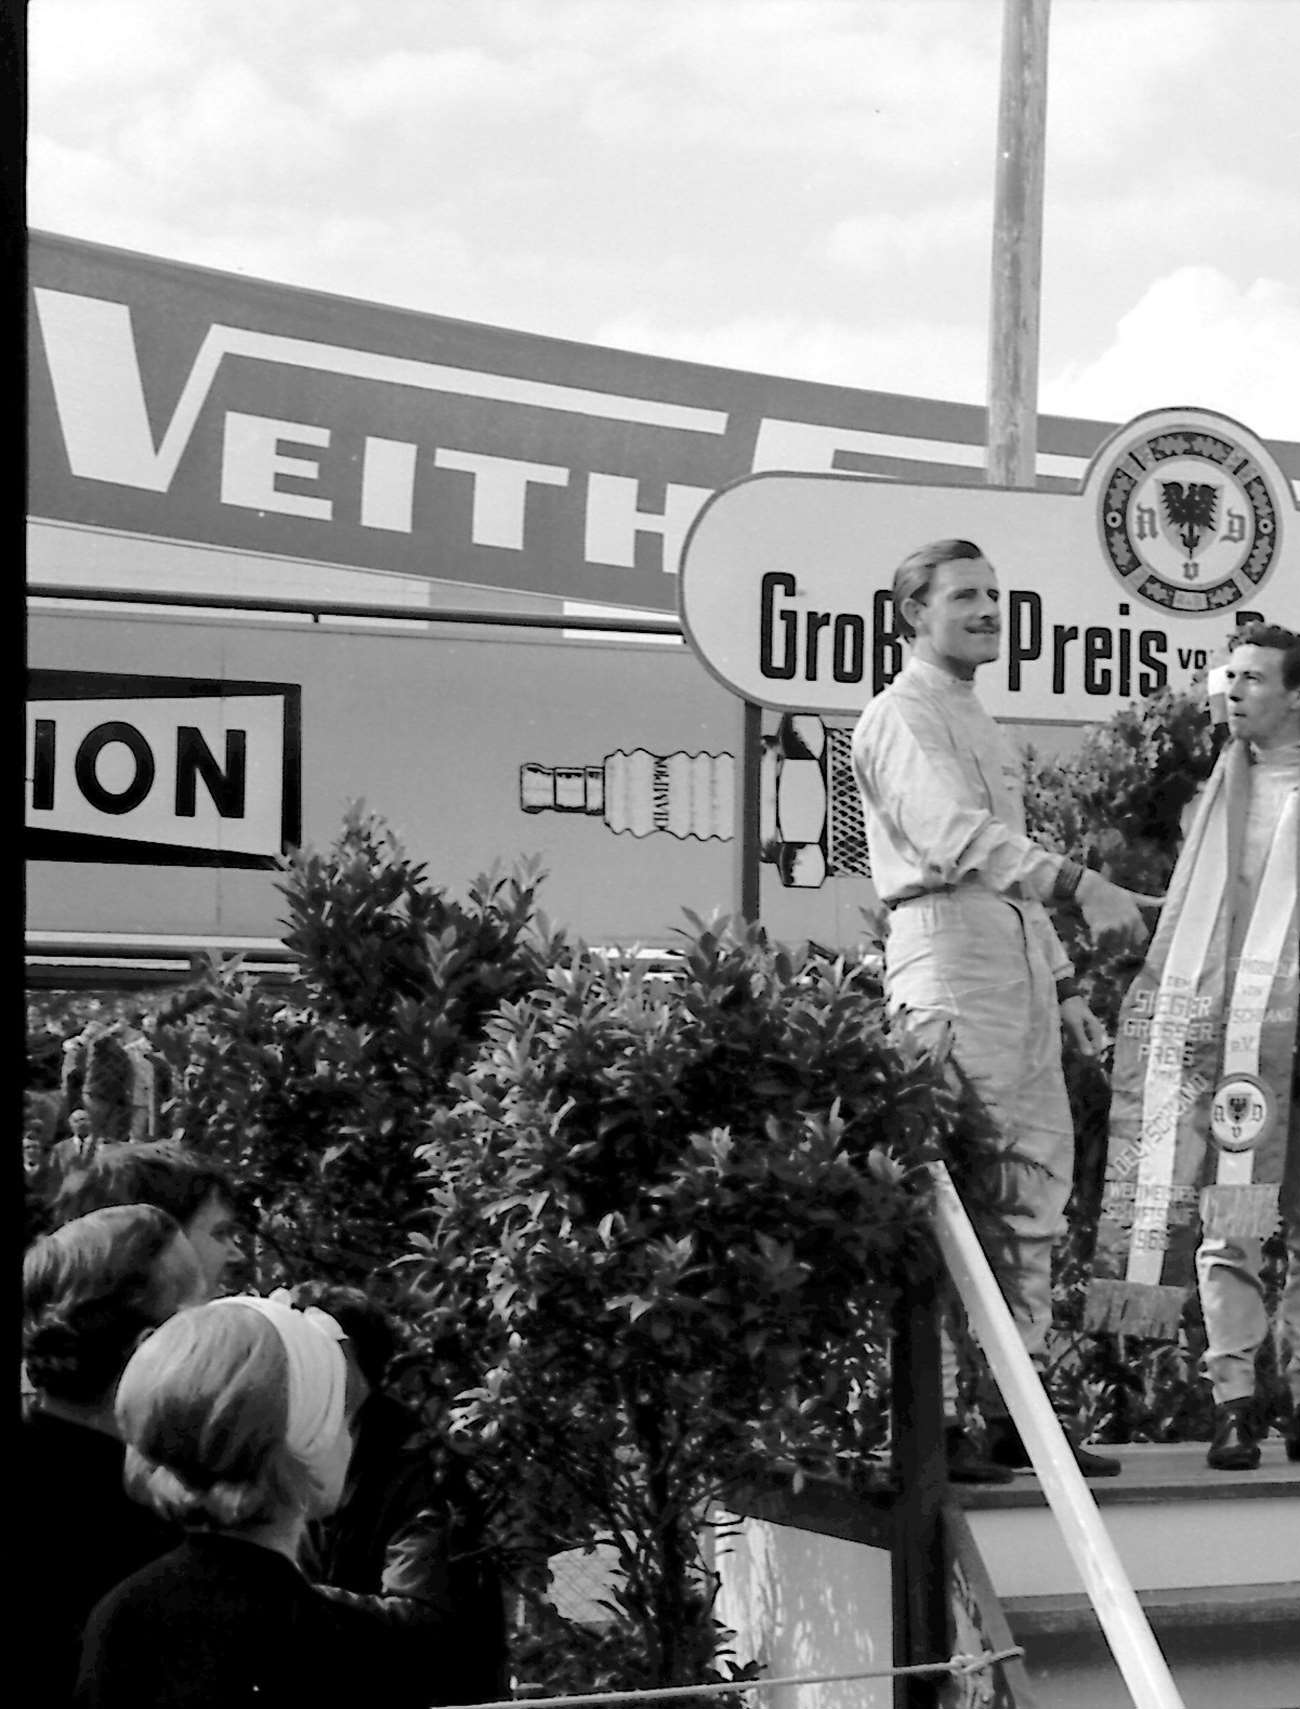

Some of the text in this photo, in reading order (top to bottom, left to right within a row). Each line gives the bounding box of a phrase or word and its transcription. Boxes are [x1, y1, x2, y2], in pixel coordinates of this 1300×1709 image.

[33, 287, 728, 575] VEITH
[1008, 590, 1169, 698] Preis
[1177, 648, 1208, 670] vo
[32, 719, 246, 820] ION
